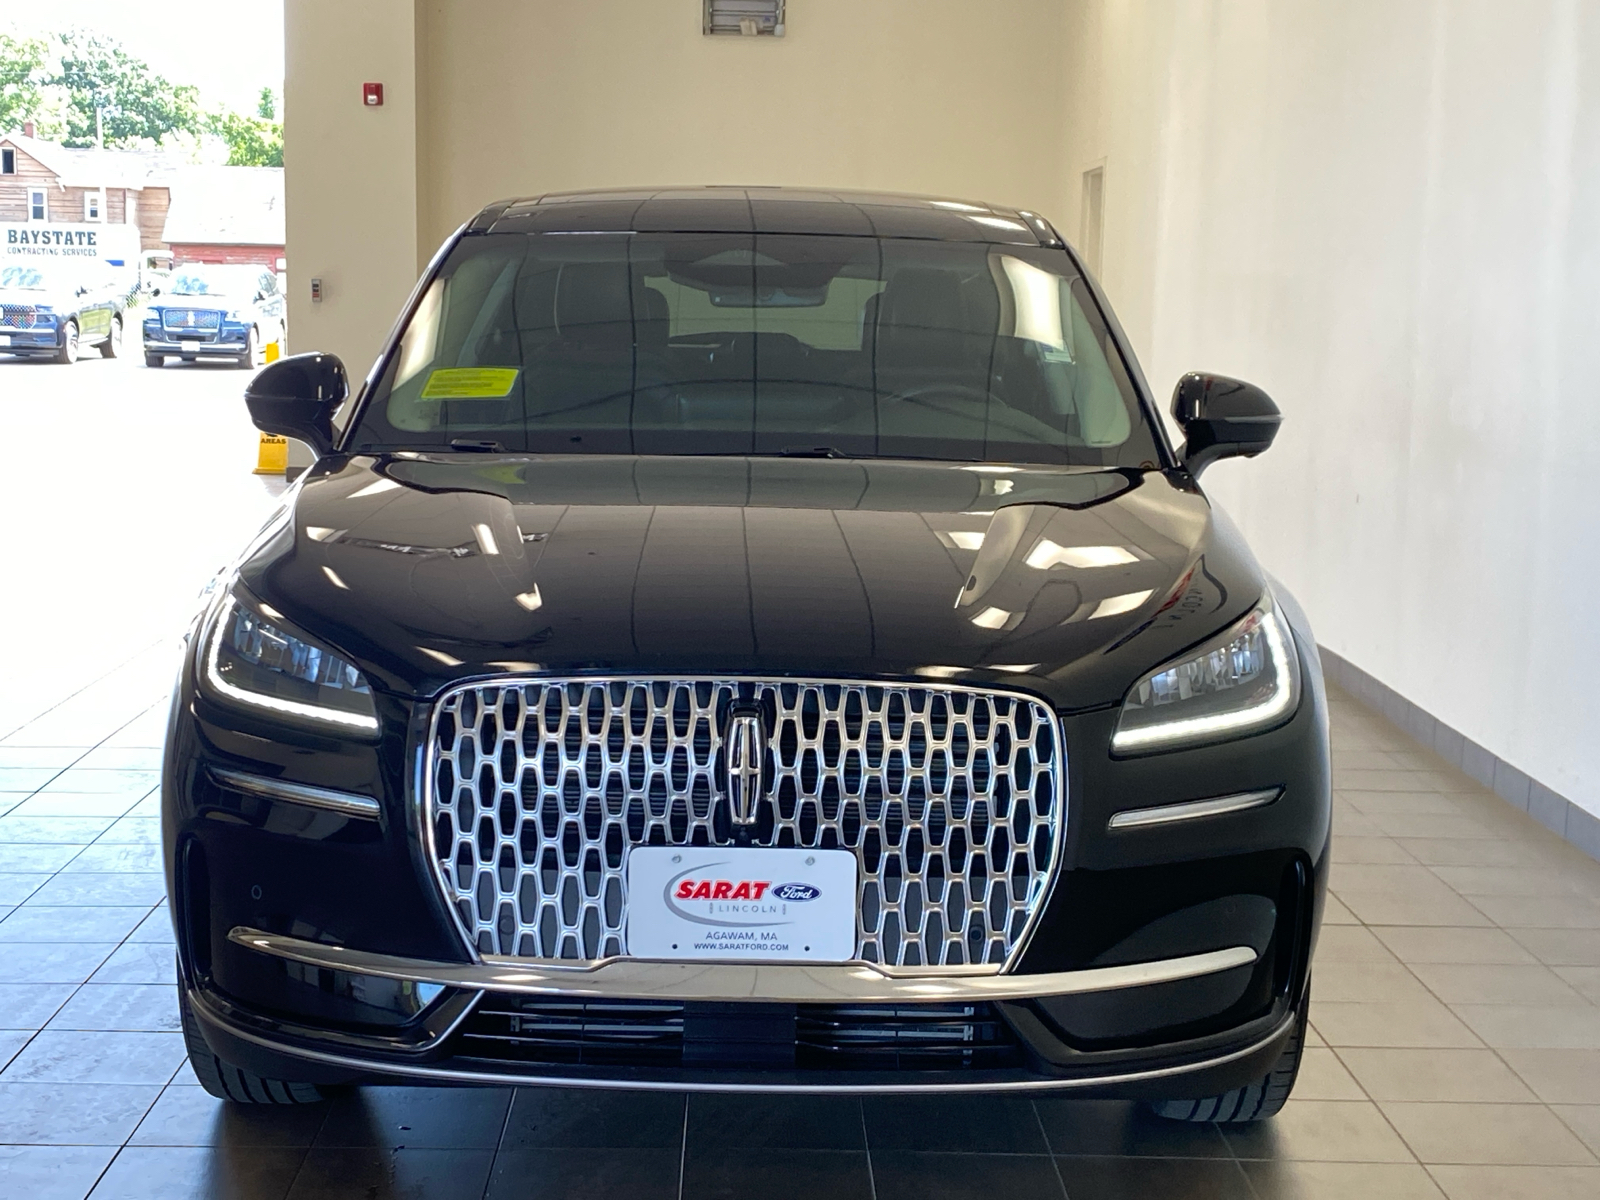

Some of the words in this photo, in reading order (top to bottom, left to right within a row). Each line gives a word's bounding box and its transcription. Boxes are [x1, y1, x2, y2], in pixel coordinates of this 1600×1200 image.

[7, 229, 97, 246] BAYSTATE
[7, 247, 58, 256] CONTRACTING
[62, 248, 97, 257] SERVICES
[674, 879, 772, 902] SARAT
[779, 884, 815, 900] Ford
[718, 904, 777, 914] LINCOLN
[705, 932, 758, 942] AGAWAM,
[760, 932, 778, 942] MA
[693, 943, 789, 952] WWW.SARATFORD.COM
